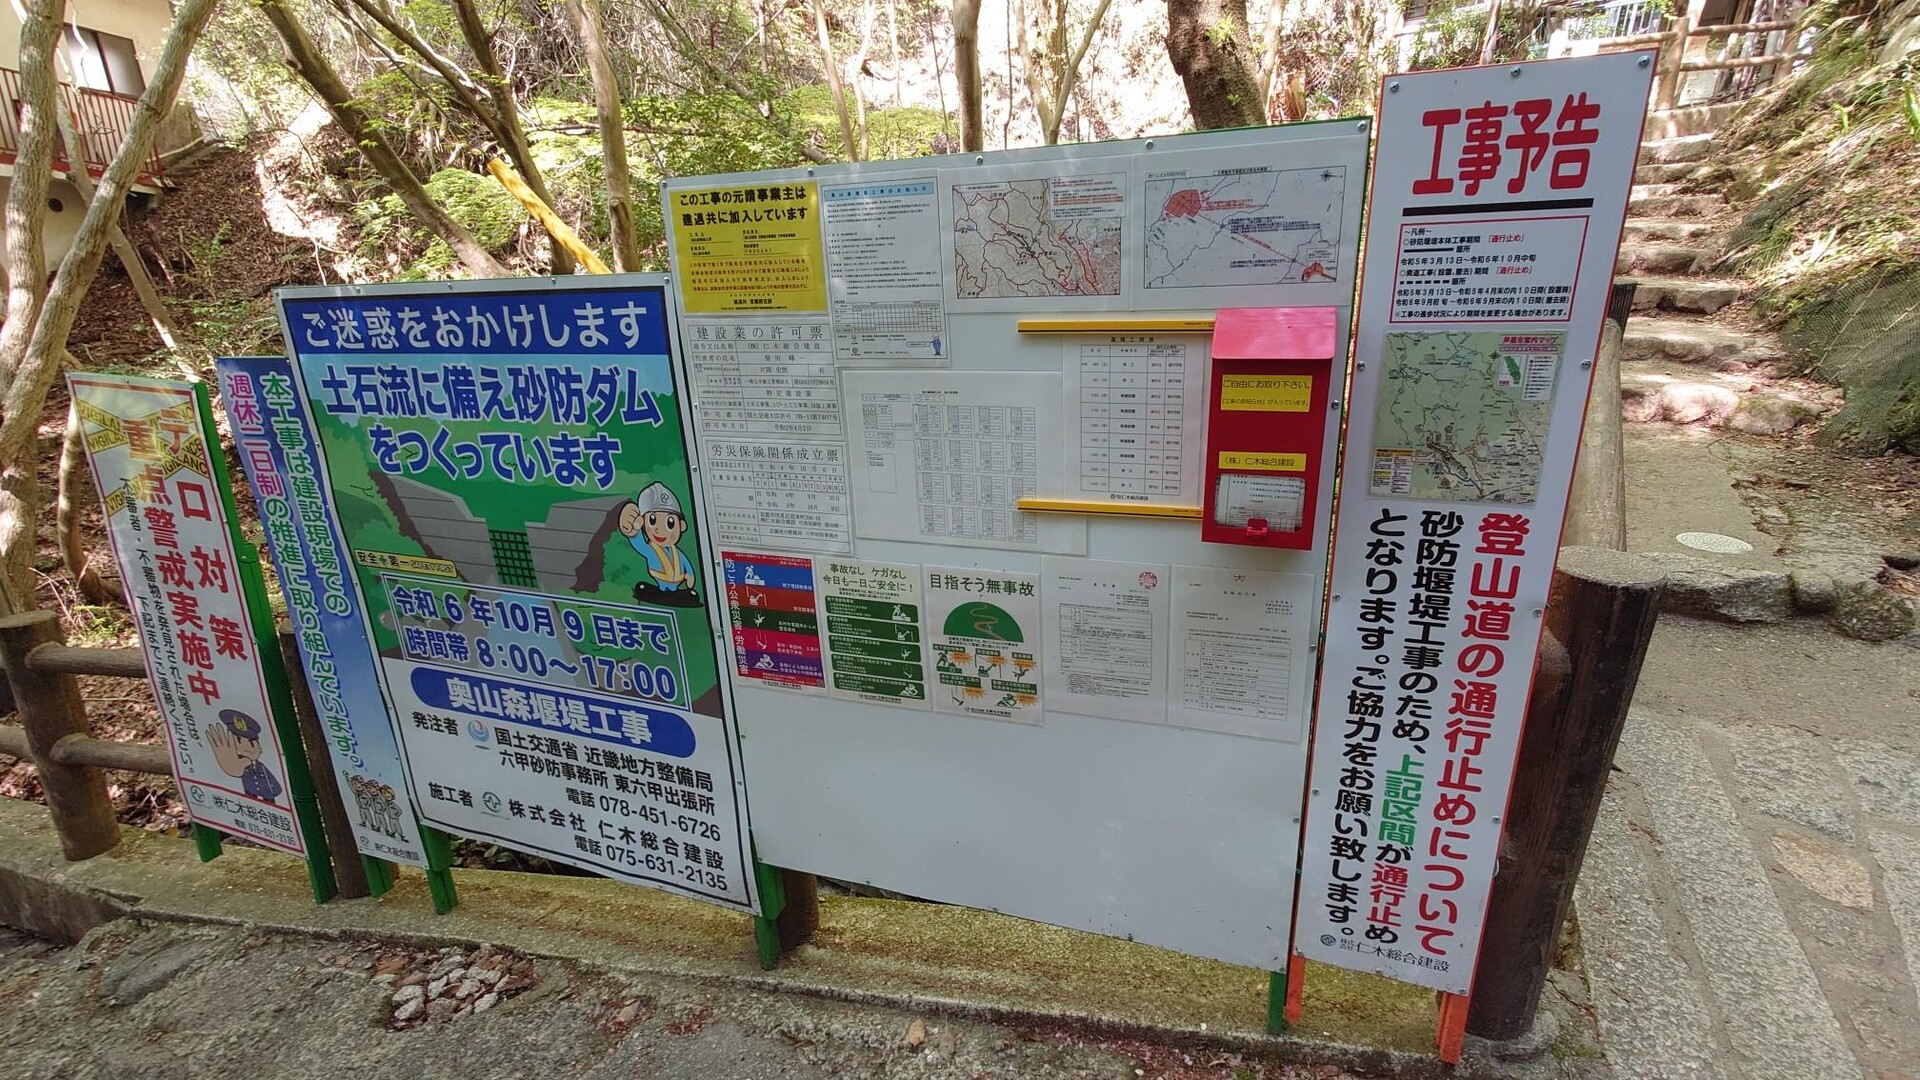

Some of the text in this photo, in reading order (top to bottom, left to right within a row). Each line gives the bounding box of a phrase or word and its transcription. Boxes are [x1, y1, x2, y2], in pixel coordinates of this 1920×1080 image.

[1412, 91, 1601, 196] 工事予告
[680, 186, 807, 206] この工事の元請事業主は
[682, 206, 808, 226] 建退共に加入しています
[302, 301, 647, 350] ご迷惑をおかけします
[697, 325, 823, 340] 建設業の許可票
[321, 365, 664, 428] 土石流に備え砂防ダム
[371, 424, 621, 488] をつくっています
[711, 445, 839, 462] 労災保険関係成立票
[262, 373, 349, 615] 本工事は建設現場での
[122, 420, 221, 707] 重点警戒実施中
[160, 409, 248, 662] テロ対策
[227, 374, 360, 765] 週休二日制の推進に取り組んでいます。
[829, 563, 907, 580] 事故なし ケガなし
[930, 573, 1035, 597] 目指そう無事故
[405, 626, 470, 662] 時間帯
[412, 711, 459, 736] 発注者
[447, 677, 653, 745] 奥山森堰堤工事
[1325, 507, 1408, 936] となります。ご協力をお願い致します。
[1415, 512, 1530, 955] 登山道の通行止めについて
[495, 726, 714, 793] 国土交通省 近畿地方整備局
[500, 750, 715, 816] 六甲砂防事務所 東六甲出張所
[428, 782, 474, 808] 施工者
[565, 787, 721, 842] 電話 078-451-6726
[508, 799, 725, 872] 株式会社 仁木総合建設
[574, 835, 728, 892] 電話 075-631-2135
[1356, 942, 1450, 973] 仁木総合建設
